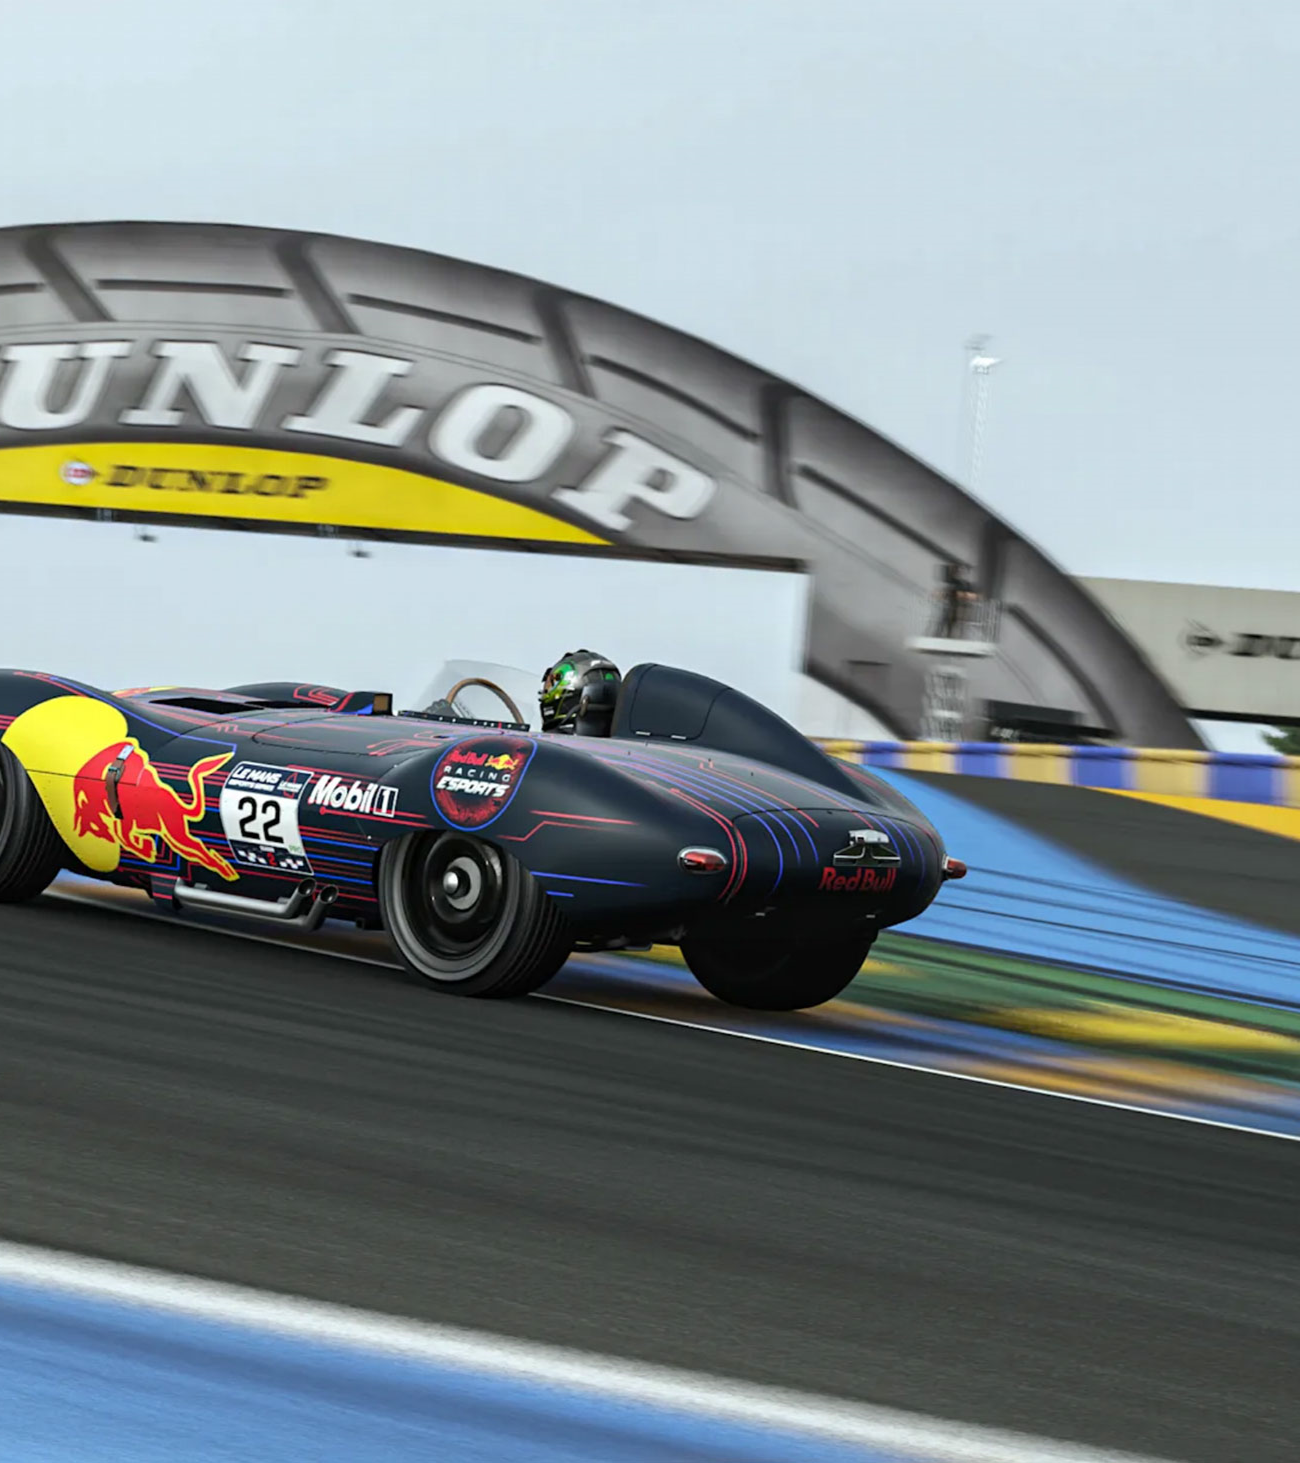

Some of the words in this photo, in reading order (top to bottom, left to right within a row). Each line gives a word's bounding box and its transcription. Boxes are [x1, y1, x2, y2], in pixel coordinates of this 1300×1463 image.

[105, 464, 329, 498] DUNLOP
[232, 766, 251, 779] LE
[246, 769, 282, 784] MANS
[436, 776, 510, 797] ESPORTS
[443, 766, 511, 782] RACING
[308, 775, 378, 813] Mobil
[238, 796, 284, 844] 22
[818, 867, 862, 891] Red
[860, 867, 897, 892] Bull
